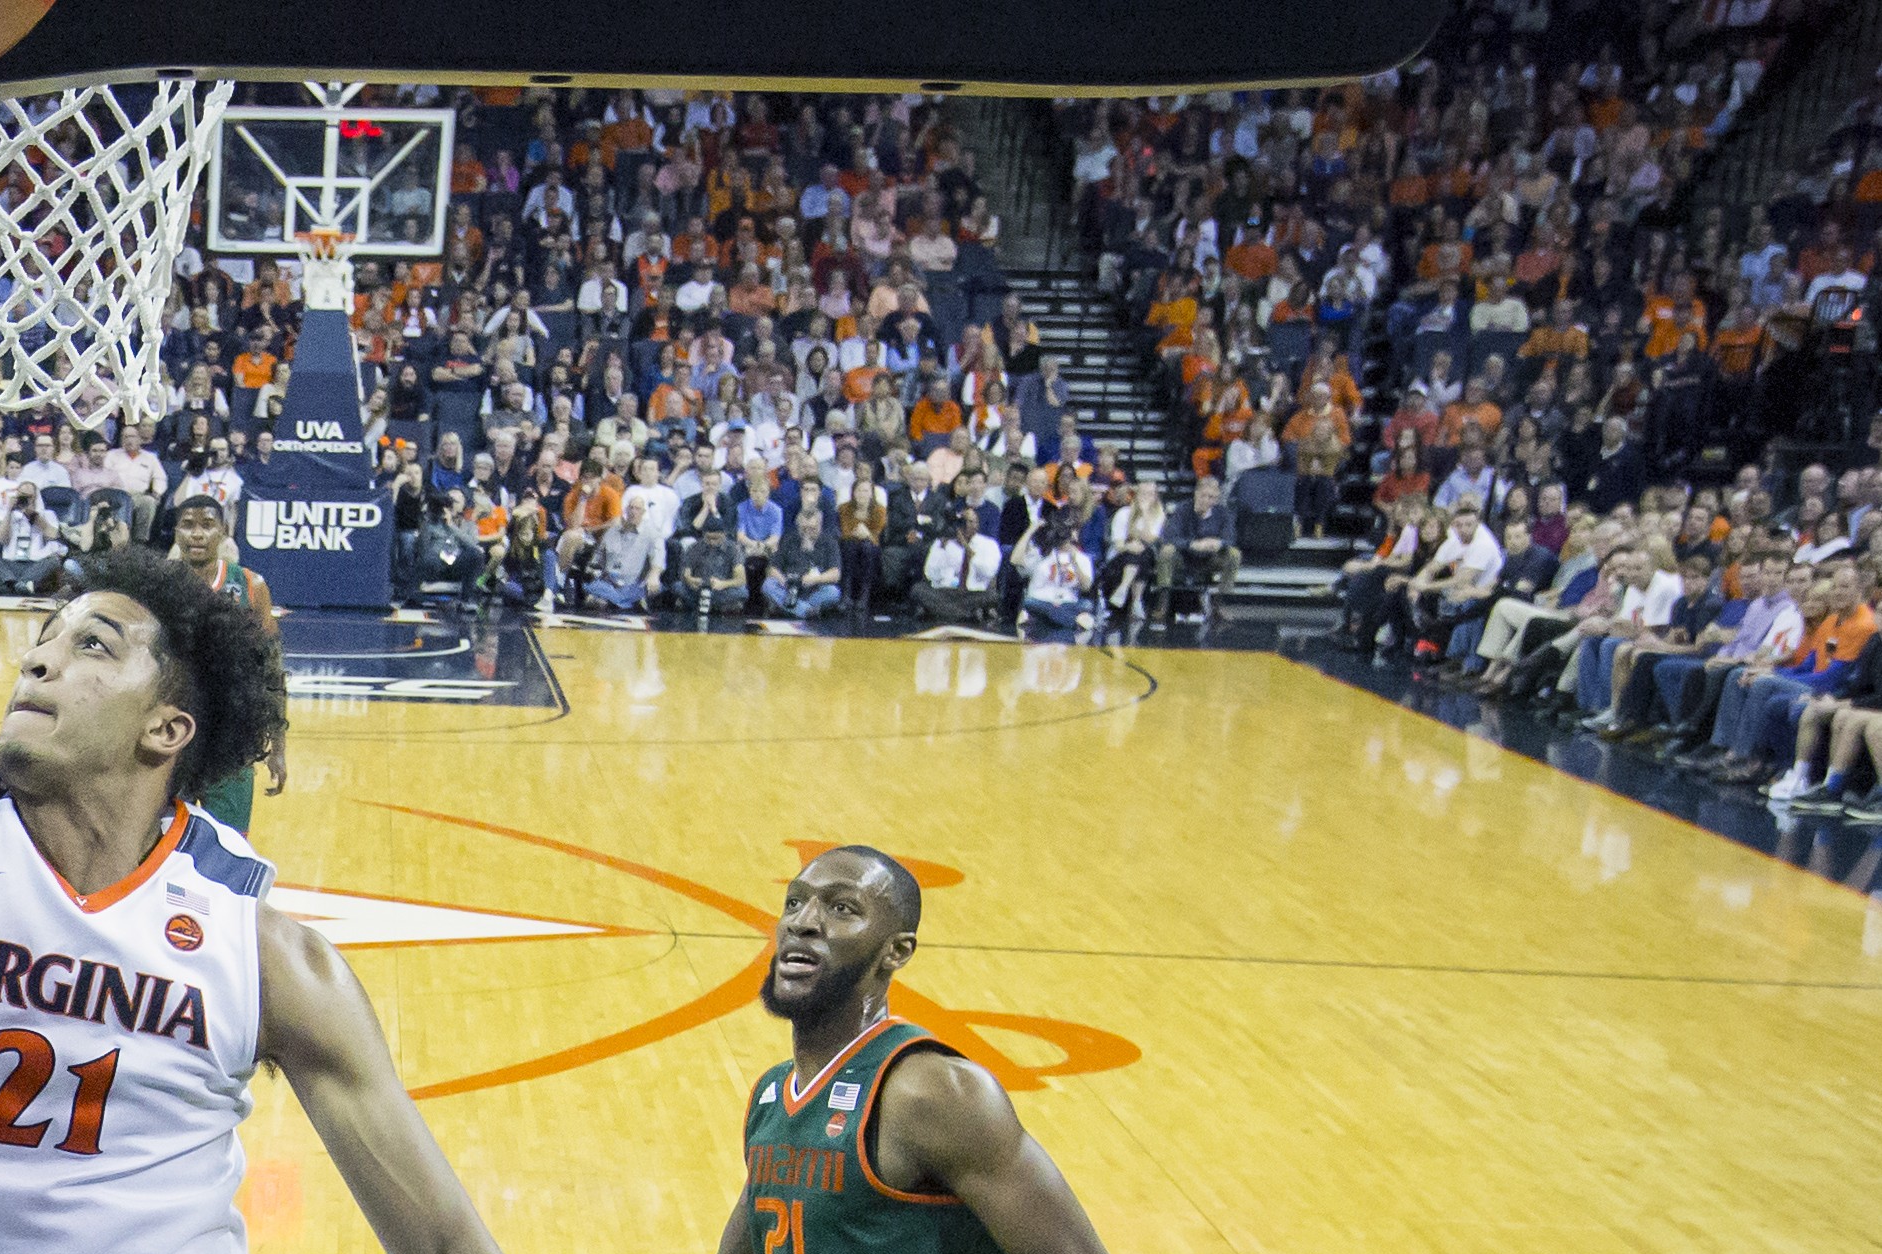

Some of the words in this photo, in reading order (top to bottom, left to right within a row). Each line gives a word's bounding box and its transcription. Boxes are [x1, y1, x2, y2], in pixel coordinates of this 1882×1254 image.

[296, 420, 344, 440] UVA
[278, 501, 383, 528] UNITED
[276, 526, 354, 551] BANK
